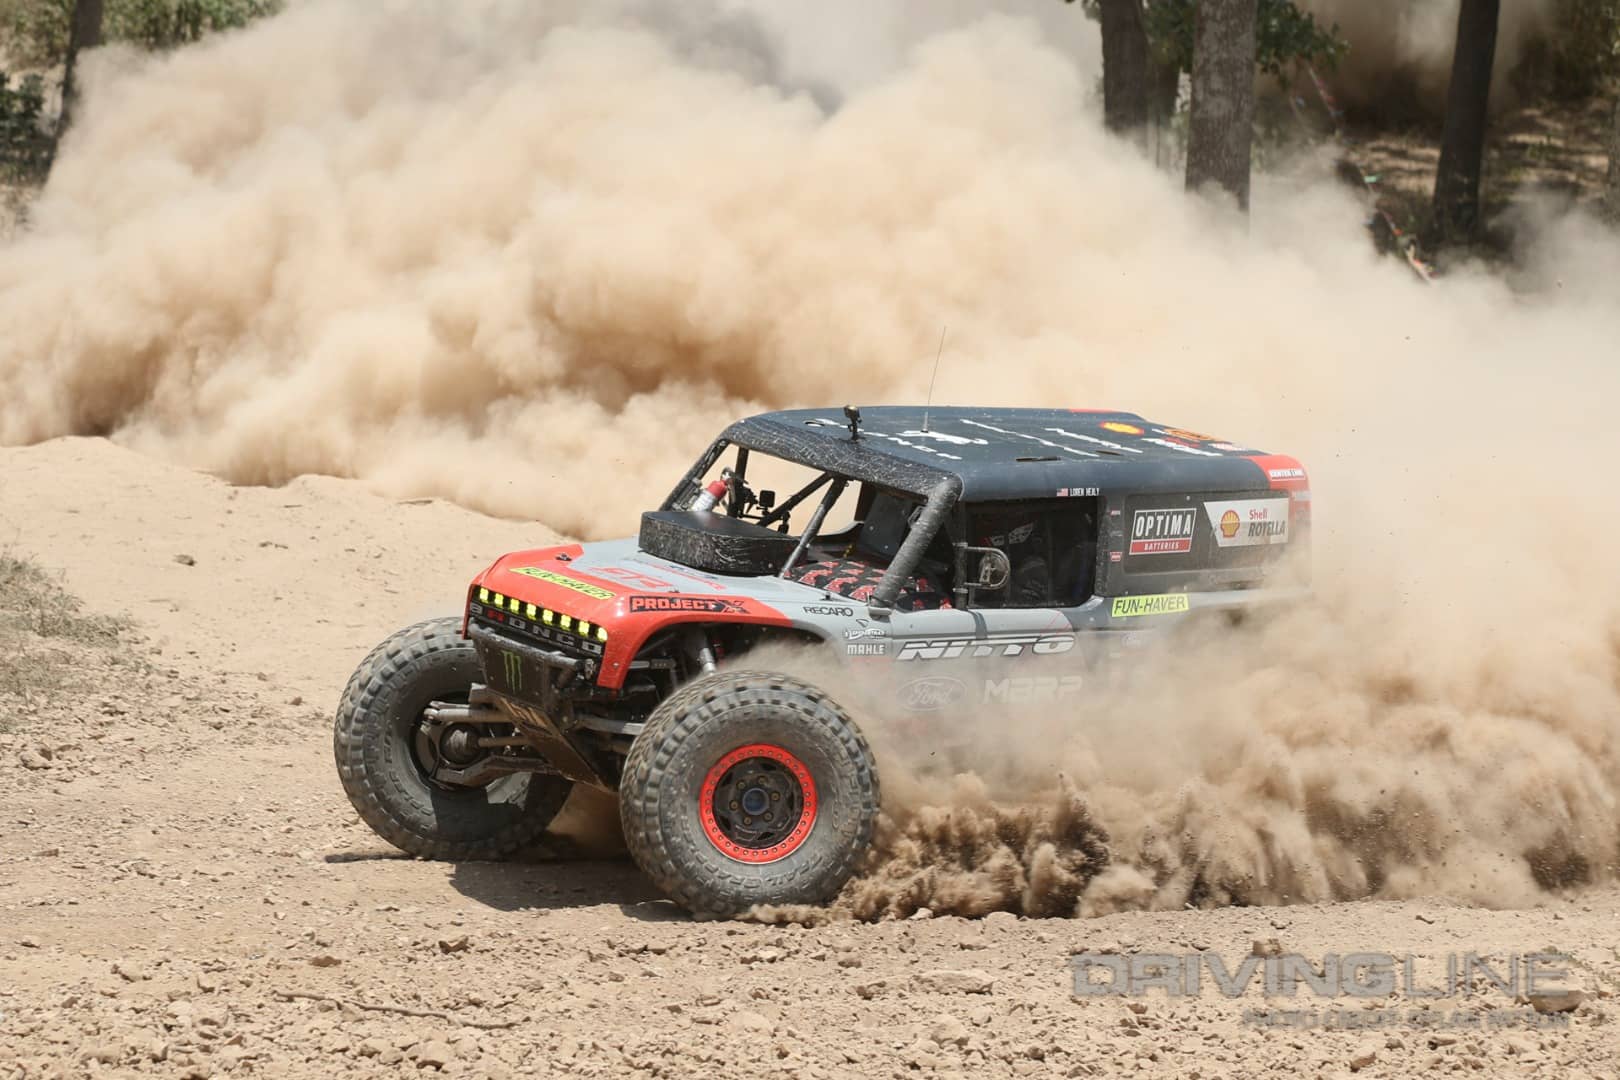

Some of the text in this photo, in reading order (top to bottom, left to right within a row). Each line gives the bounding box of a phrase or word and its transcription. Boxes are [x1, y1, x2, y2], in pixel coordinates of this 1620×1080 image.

[1249, 509, 1268, 520] Shell
[1135, 514, 1192, 537] OPTIMA
[1248, 521, 1286, 537] ROTELLA
[1144, 542, 1179, 551] BATTERIES
[632, 598, 718, 610] PROJECT
[803, 606, 854, 617] RECARO
[1114, 597, 1186, 614] FUN-HAVER
[470, 602, 602, 654] BRONCO
[847, 644, 885, 655] MAHLE
[897, 636, 1075, 661] NITTO
[909, 680, 952, 705] Ford
